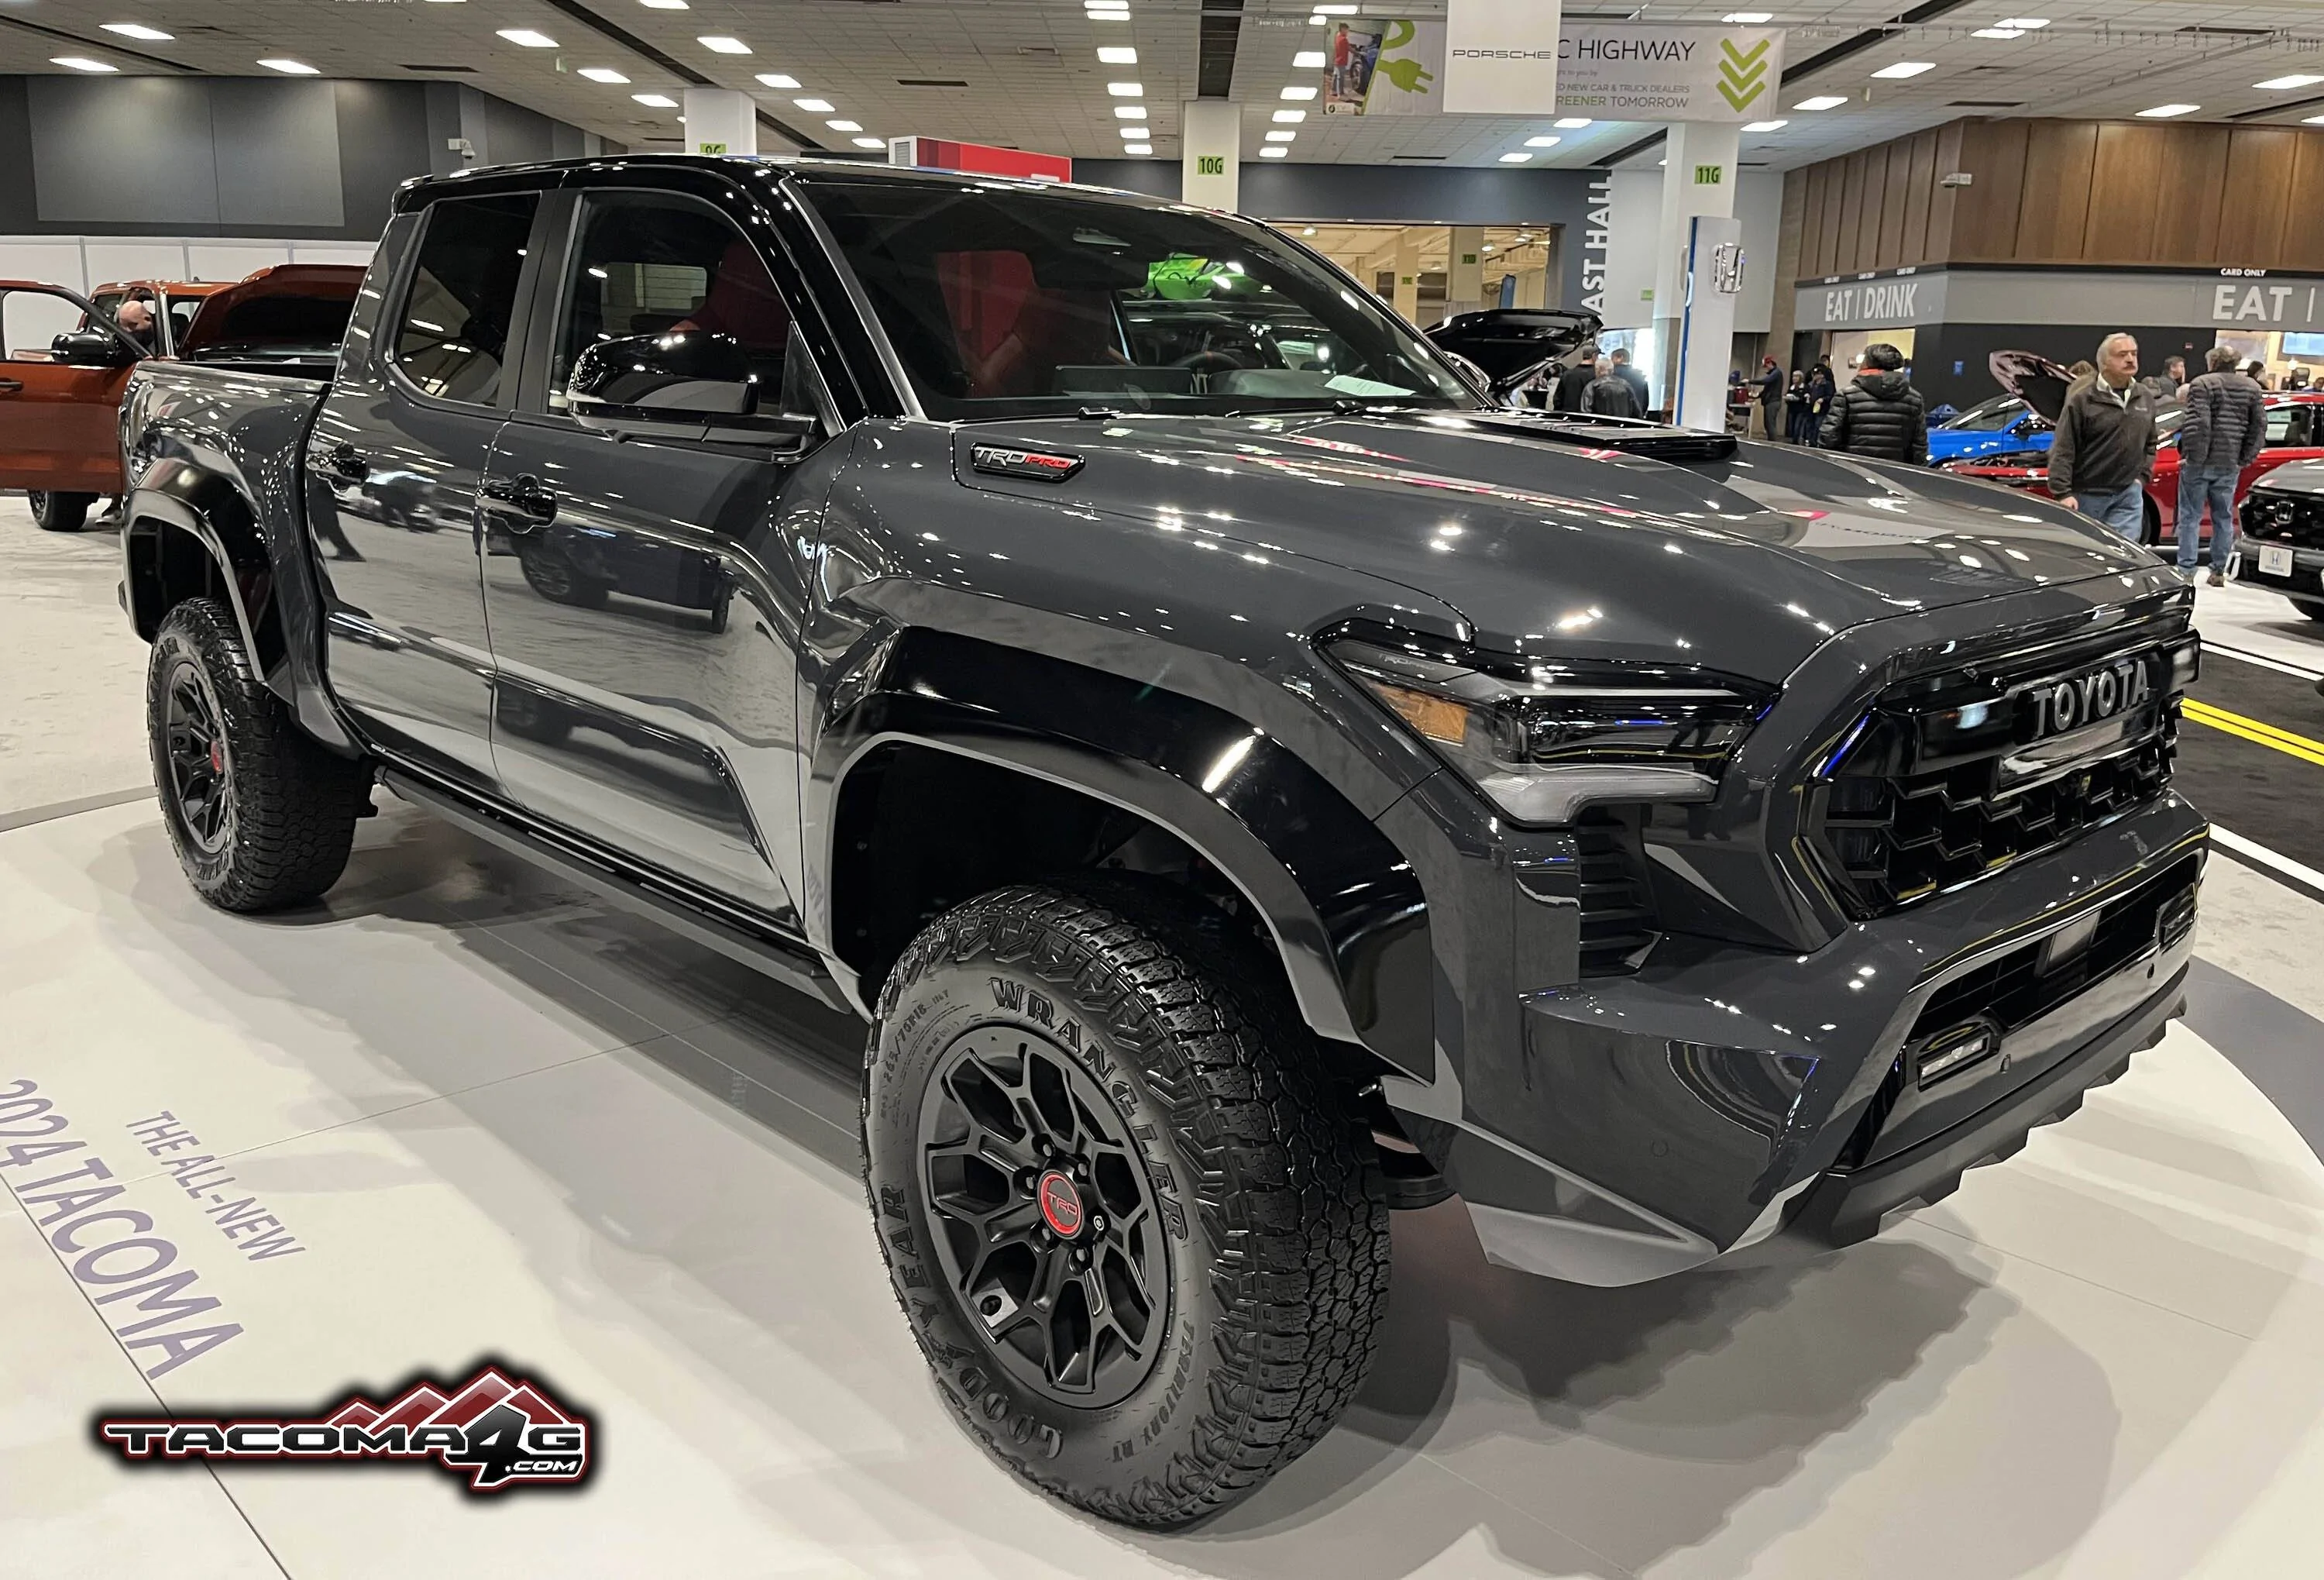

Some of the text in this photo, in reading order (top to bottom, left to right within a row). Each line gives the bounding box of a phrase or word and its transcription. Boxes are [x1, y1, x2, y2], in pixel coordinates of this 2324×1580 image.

[1452, 50, 1551, 59] PORSCHE
[1578, 39, 1696, 61] HIGHWAY
[1650, 85, 1690, 94] DEALERS
[1610, 96, 1690, 108] TOMORROW
[1201, 158, 1222, 174] 10G
[1697, 167, 1720, 184] 11G
[1585, 176, 1612, 249] HALL
[2220, 268, 2243, 277] CARD
[1825, 283, 1918, 322] EAT DRINK
[2213, 285, 2292, 322] EAT
[2032, 660, 2148, 739] TOYOTA
[988, 977, 1189, 1241] WRANGLER
[126, 1110, 306, 1261] THE ALL-NEW
[1047, 1192, 1078, 1216] TRD
[14, 1157, 244, 1380] TACOMA
